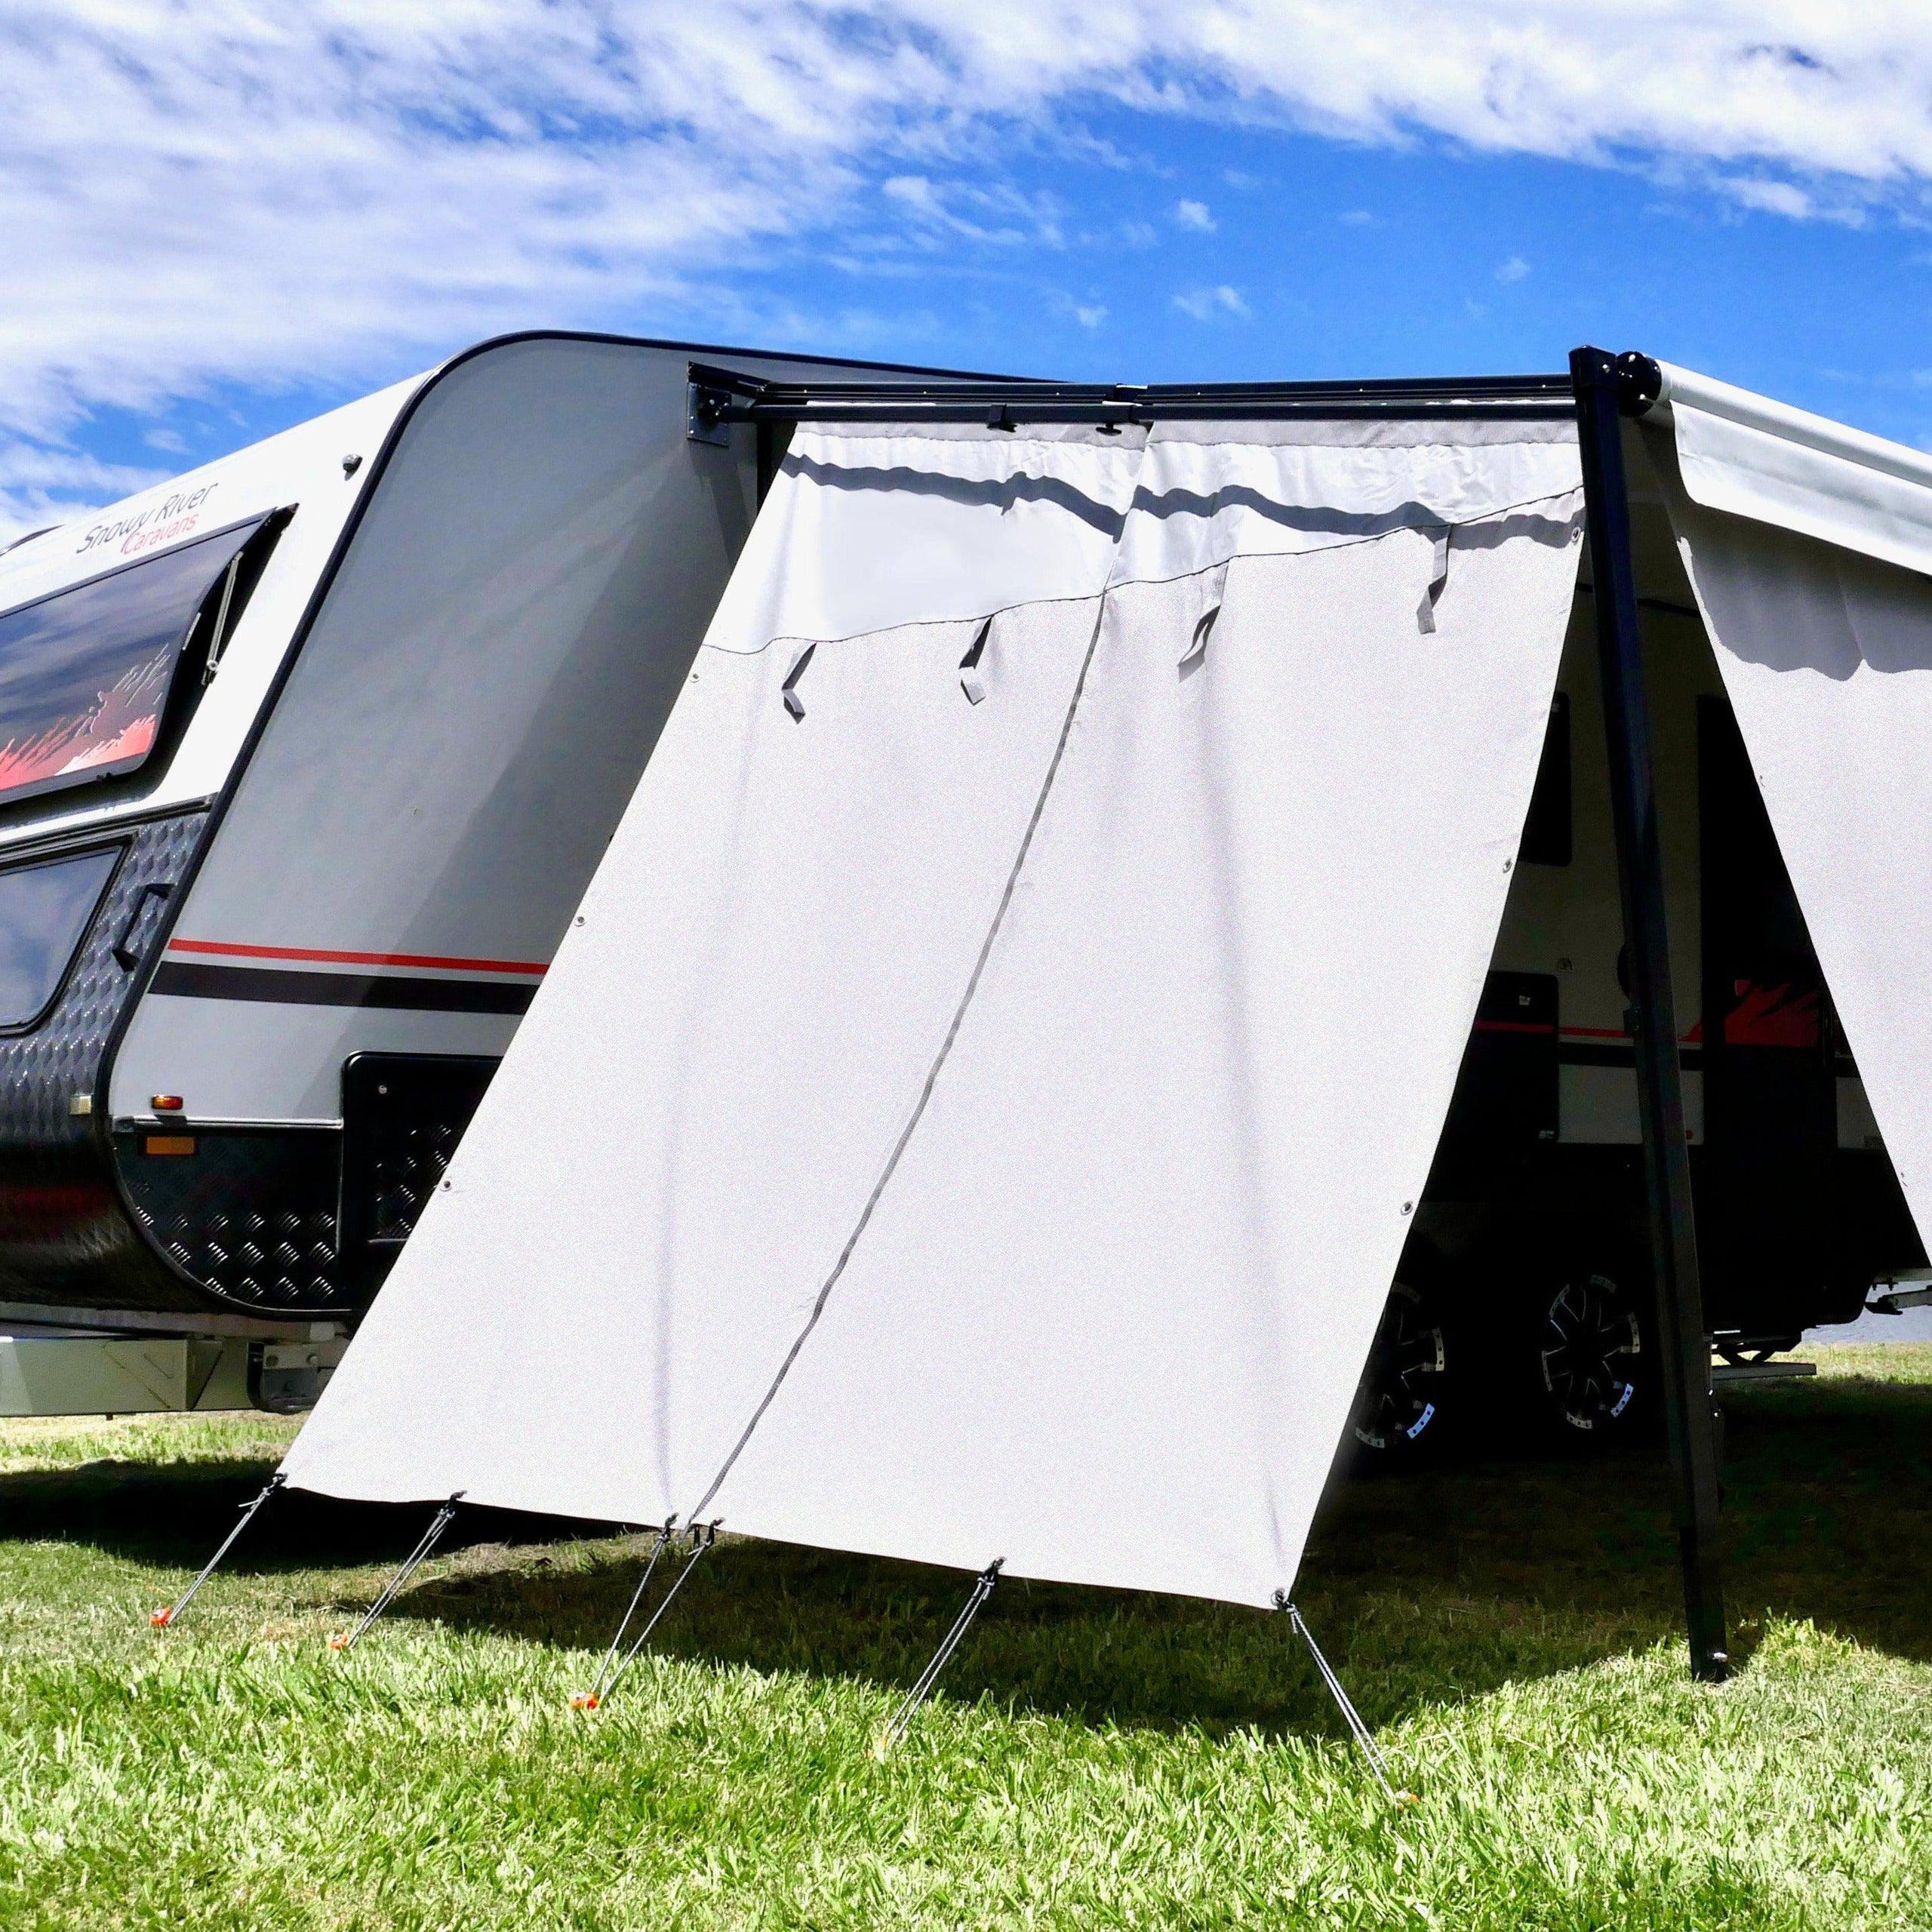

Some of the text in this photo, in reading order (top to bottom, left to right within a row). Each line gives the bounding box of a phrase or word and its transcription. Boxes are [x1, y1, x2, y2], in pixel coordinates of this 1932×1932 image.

[76, 483, 218, 554] Snowy River
[121, 514, 198, 555] Caravans
